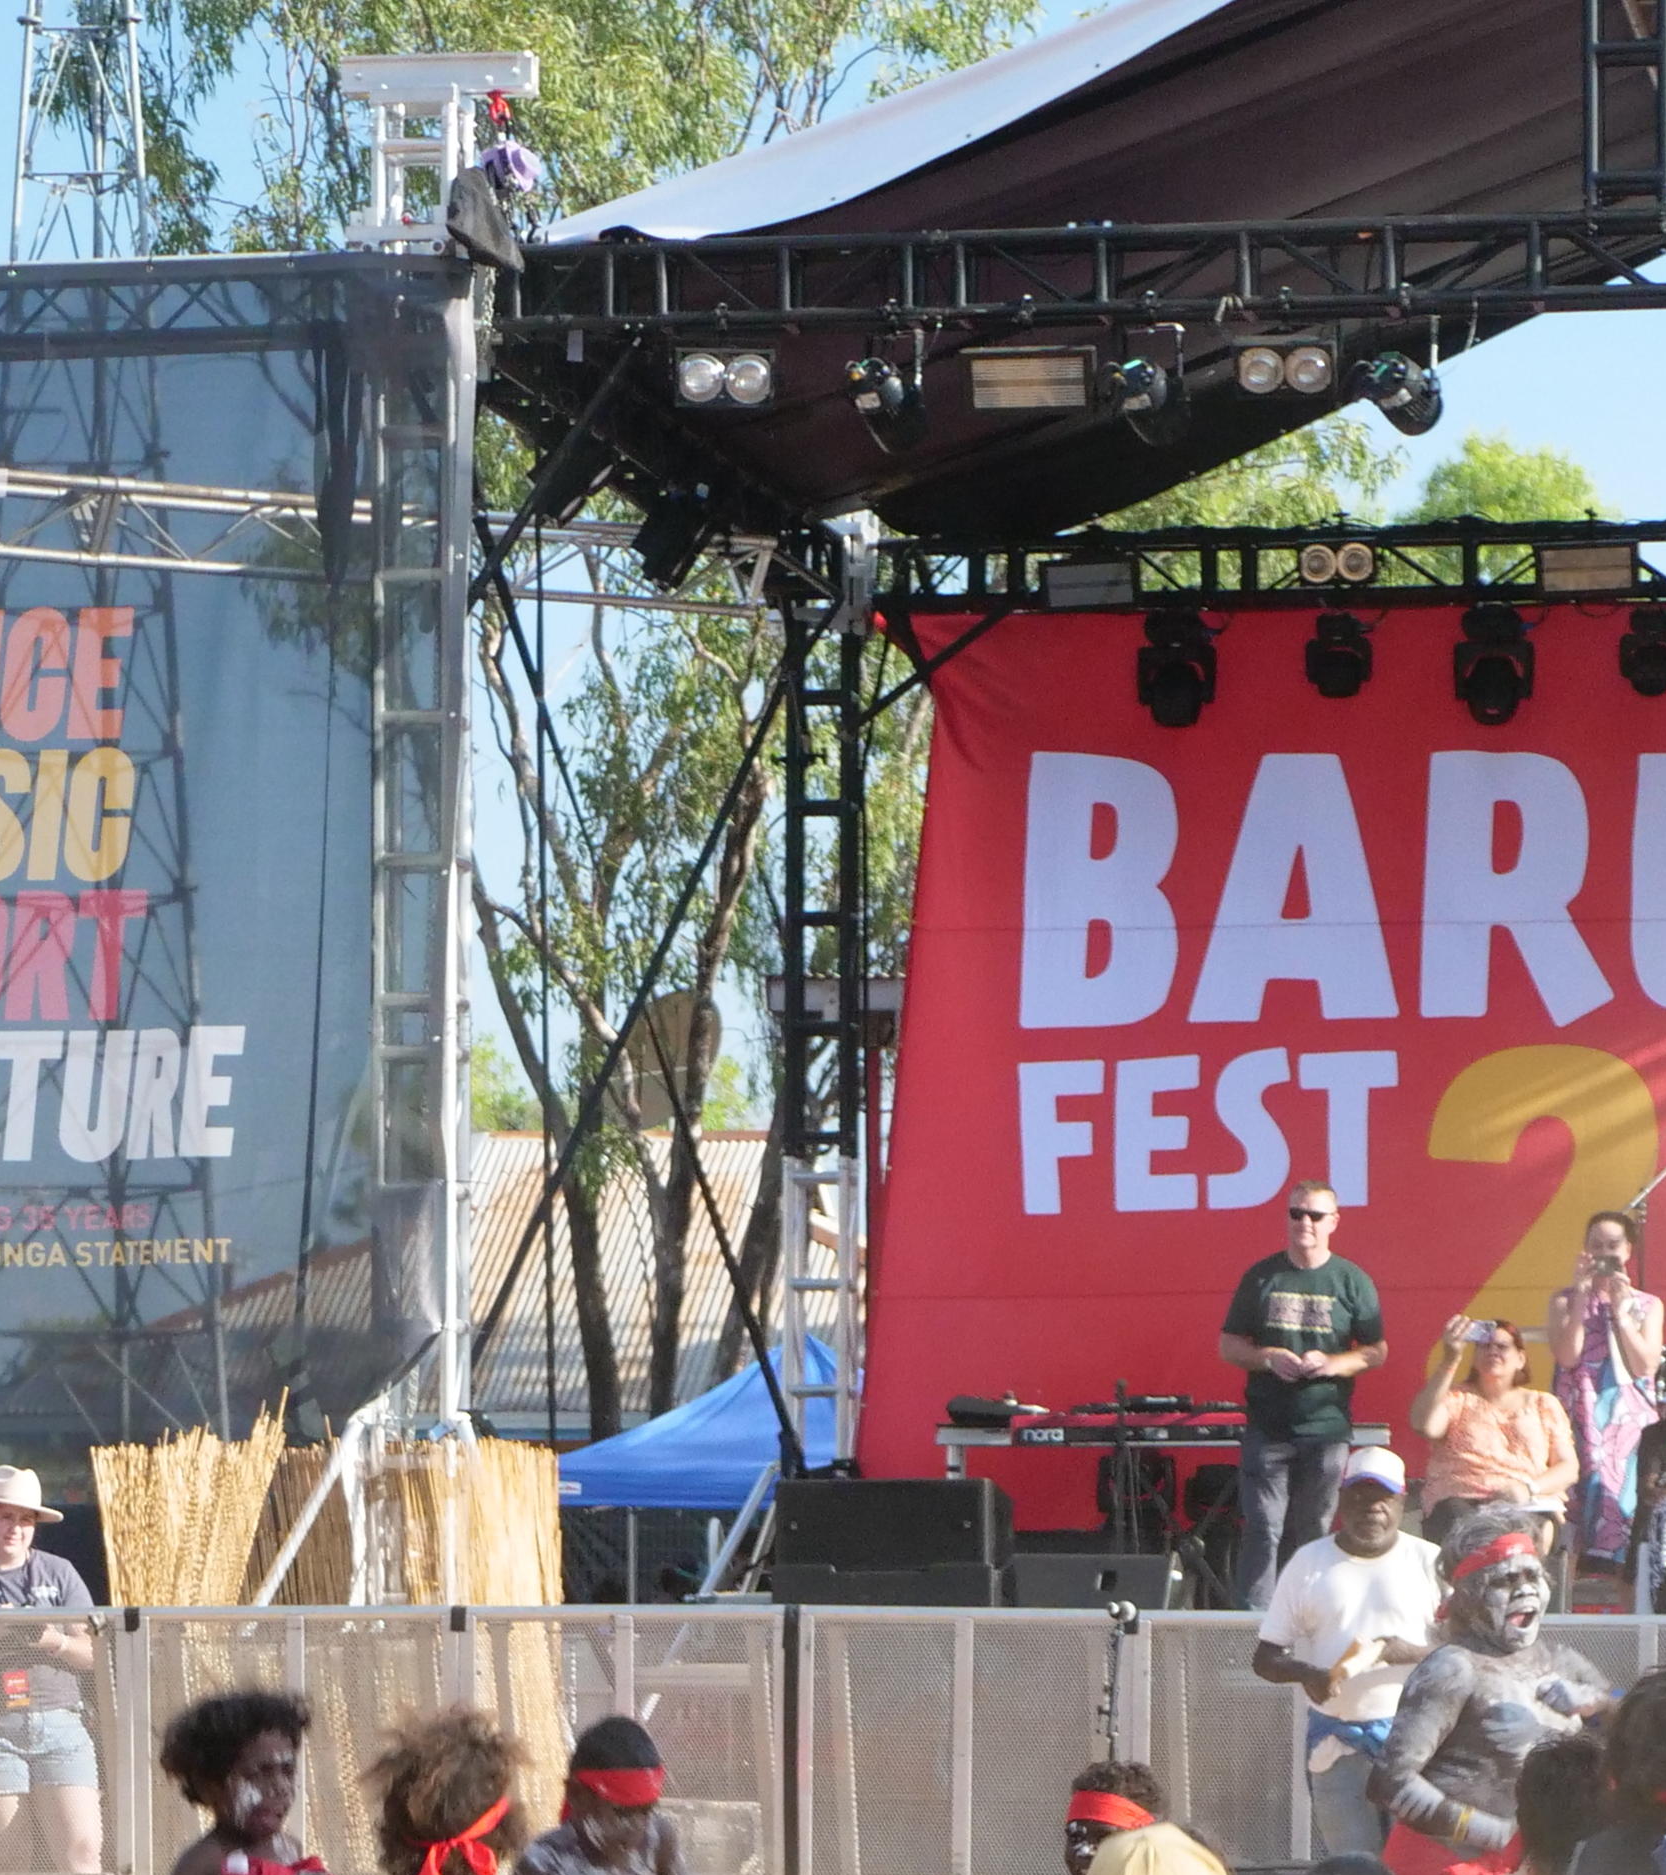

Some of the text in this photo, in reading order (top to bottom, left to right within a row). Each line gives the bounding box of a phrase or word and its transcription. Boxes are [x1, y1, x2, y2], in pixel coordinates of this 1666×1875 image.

[1017, 1046, 1399, 1215] FEST
[22, 1206, 56, 1231] 35
[63, 1203, 155, 1231] YEARS
[76, 1238, 232, 1267] STATEMENT
